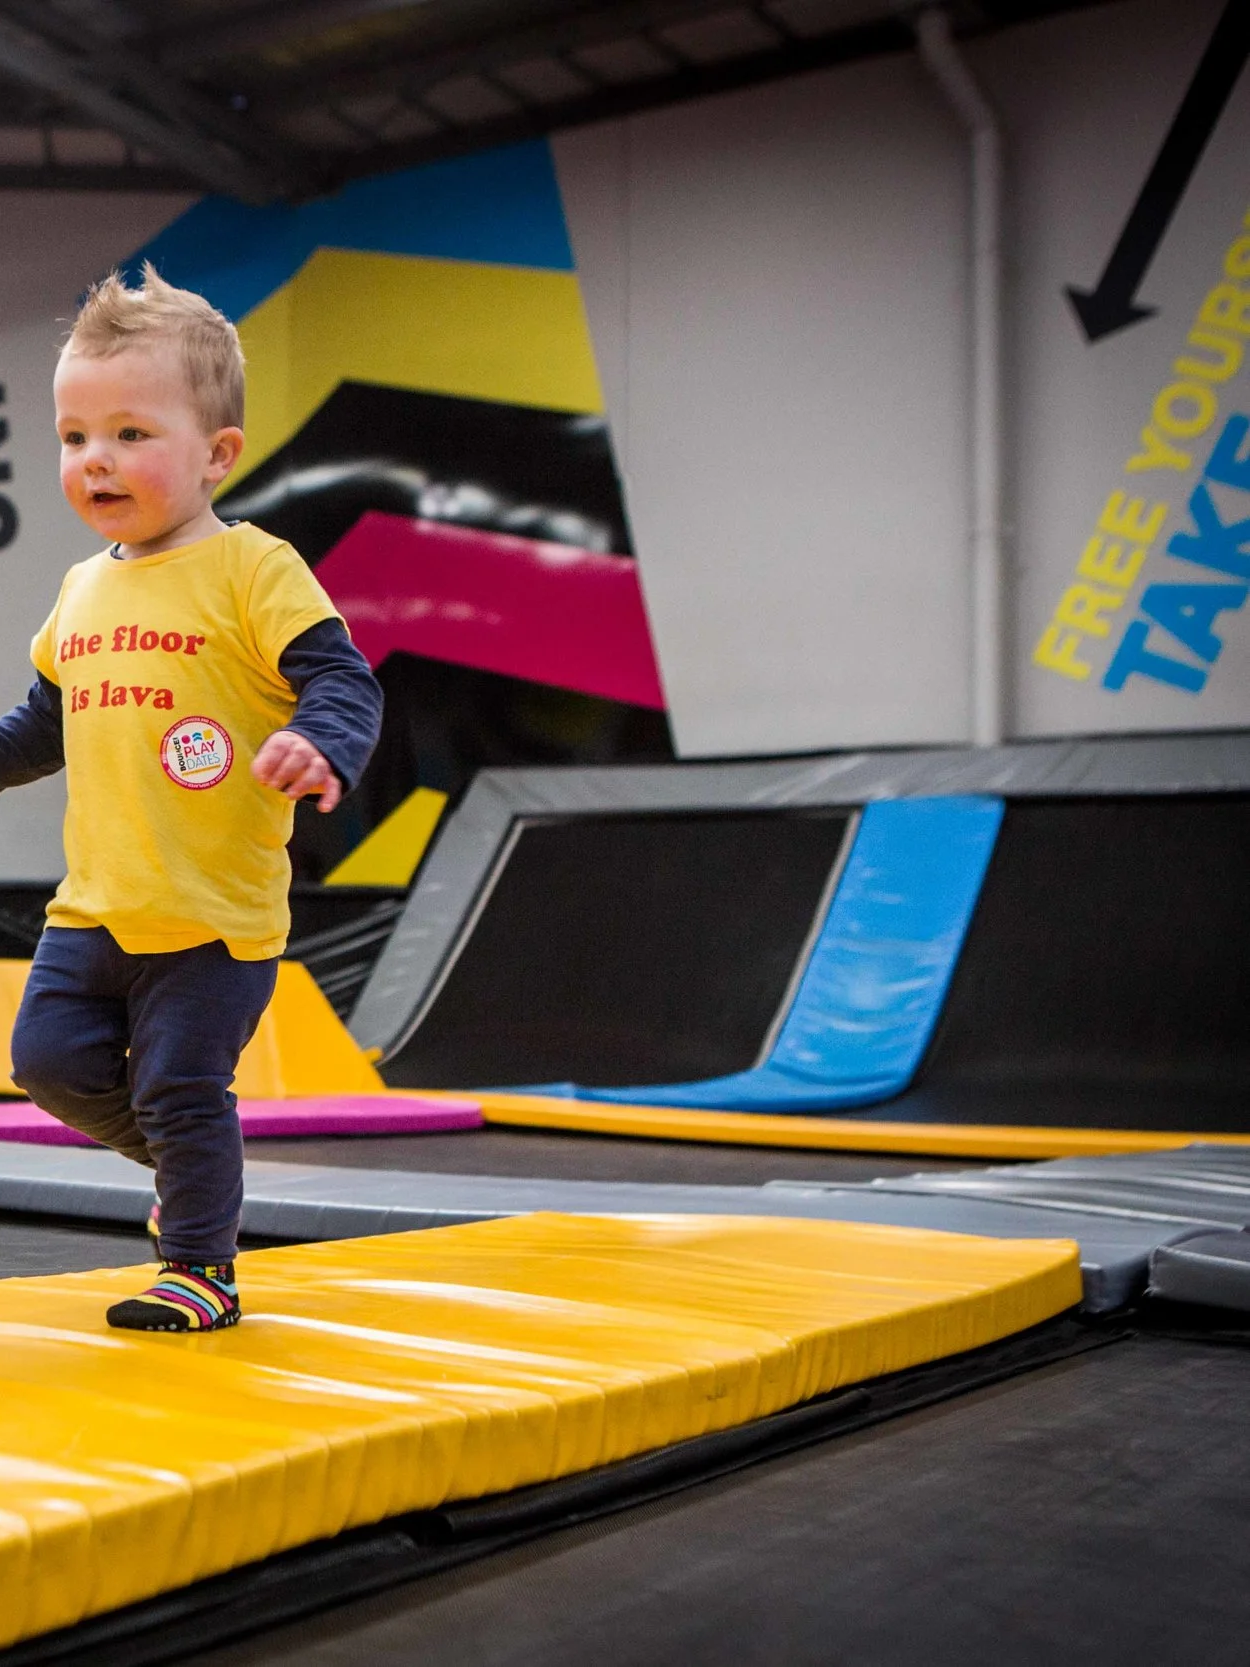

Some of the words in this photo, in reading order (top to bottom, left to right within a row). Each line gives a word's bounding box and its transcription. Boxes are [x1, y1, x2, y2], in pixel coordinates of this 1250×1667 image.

[1031, 488, 1169, 683] FREE
[1125, 205, 1250, 474] YOUR
[59, 632, 103, 663] the
[110, 623, 206, 656] floor
[70, 685, 90, 713] is
[98, 680, 175, 710] lava
[184, 740, 216, 758] PLAY
[186, 752, 221, 770] DATES
